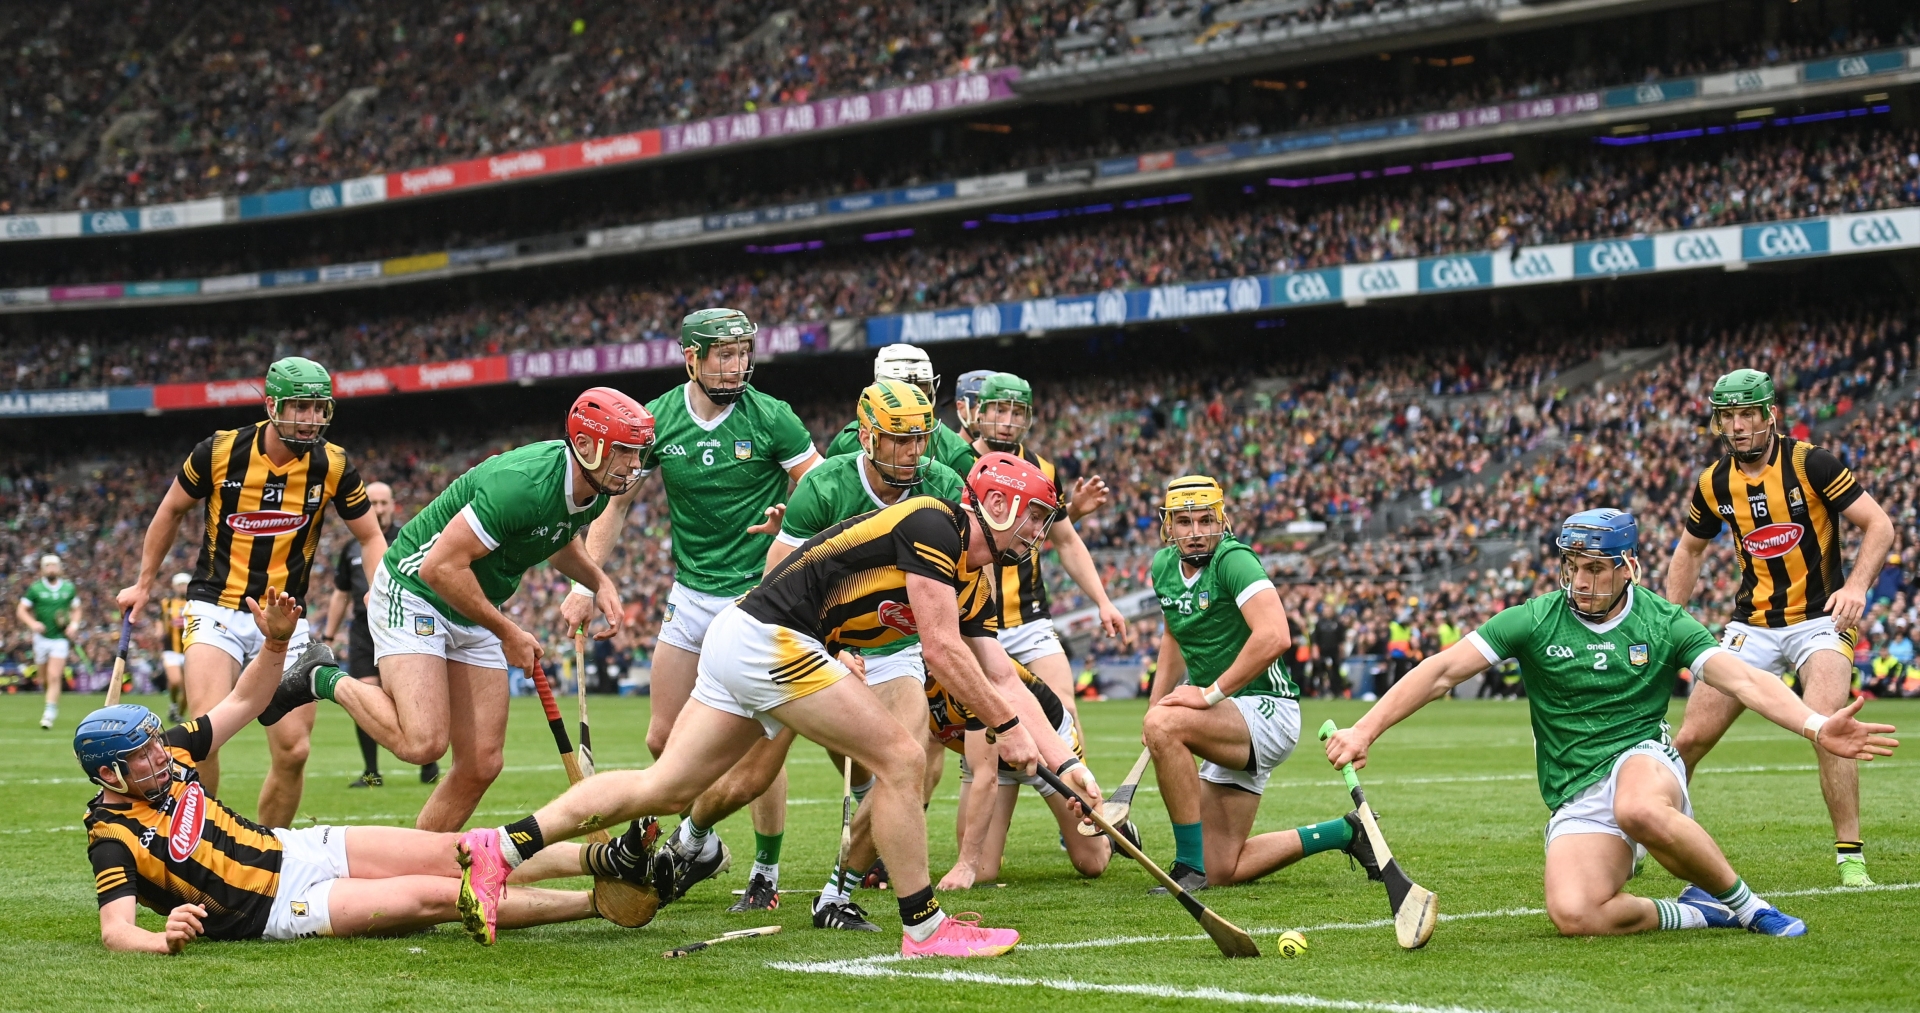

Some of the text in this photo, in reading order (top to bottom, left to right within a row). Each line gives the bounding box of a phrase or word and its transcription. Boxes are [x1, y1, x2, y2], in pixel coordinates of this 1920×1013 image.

[1149, 284, 1227, 319] Allianz
[1021, 300, 1094, 331] Allianz
[902, 311, 970, 342] Allianz
[697, 439, 721, 448] oneills
[702, 449, 715, 466] 6
[263, 488, 283, 503] 21
[1751, 502, 1767, 518] 15
[232, 516, 304, 529] Avonmore
[551, 528, 563, 544] 4
[1175, 599, 1193, 615] 25
[1546, 645, 1574, 658] GAA
[1586, 642, 1615, 650] oneills
[1593, 653, 1608, 670] 2
[171, 786, 199, 855] Avonmore
